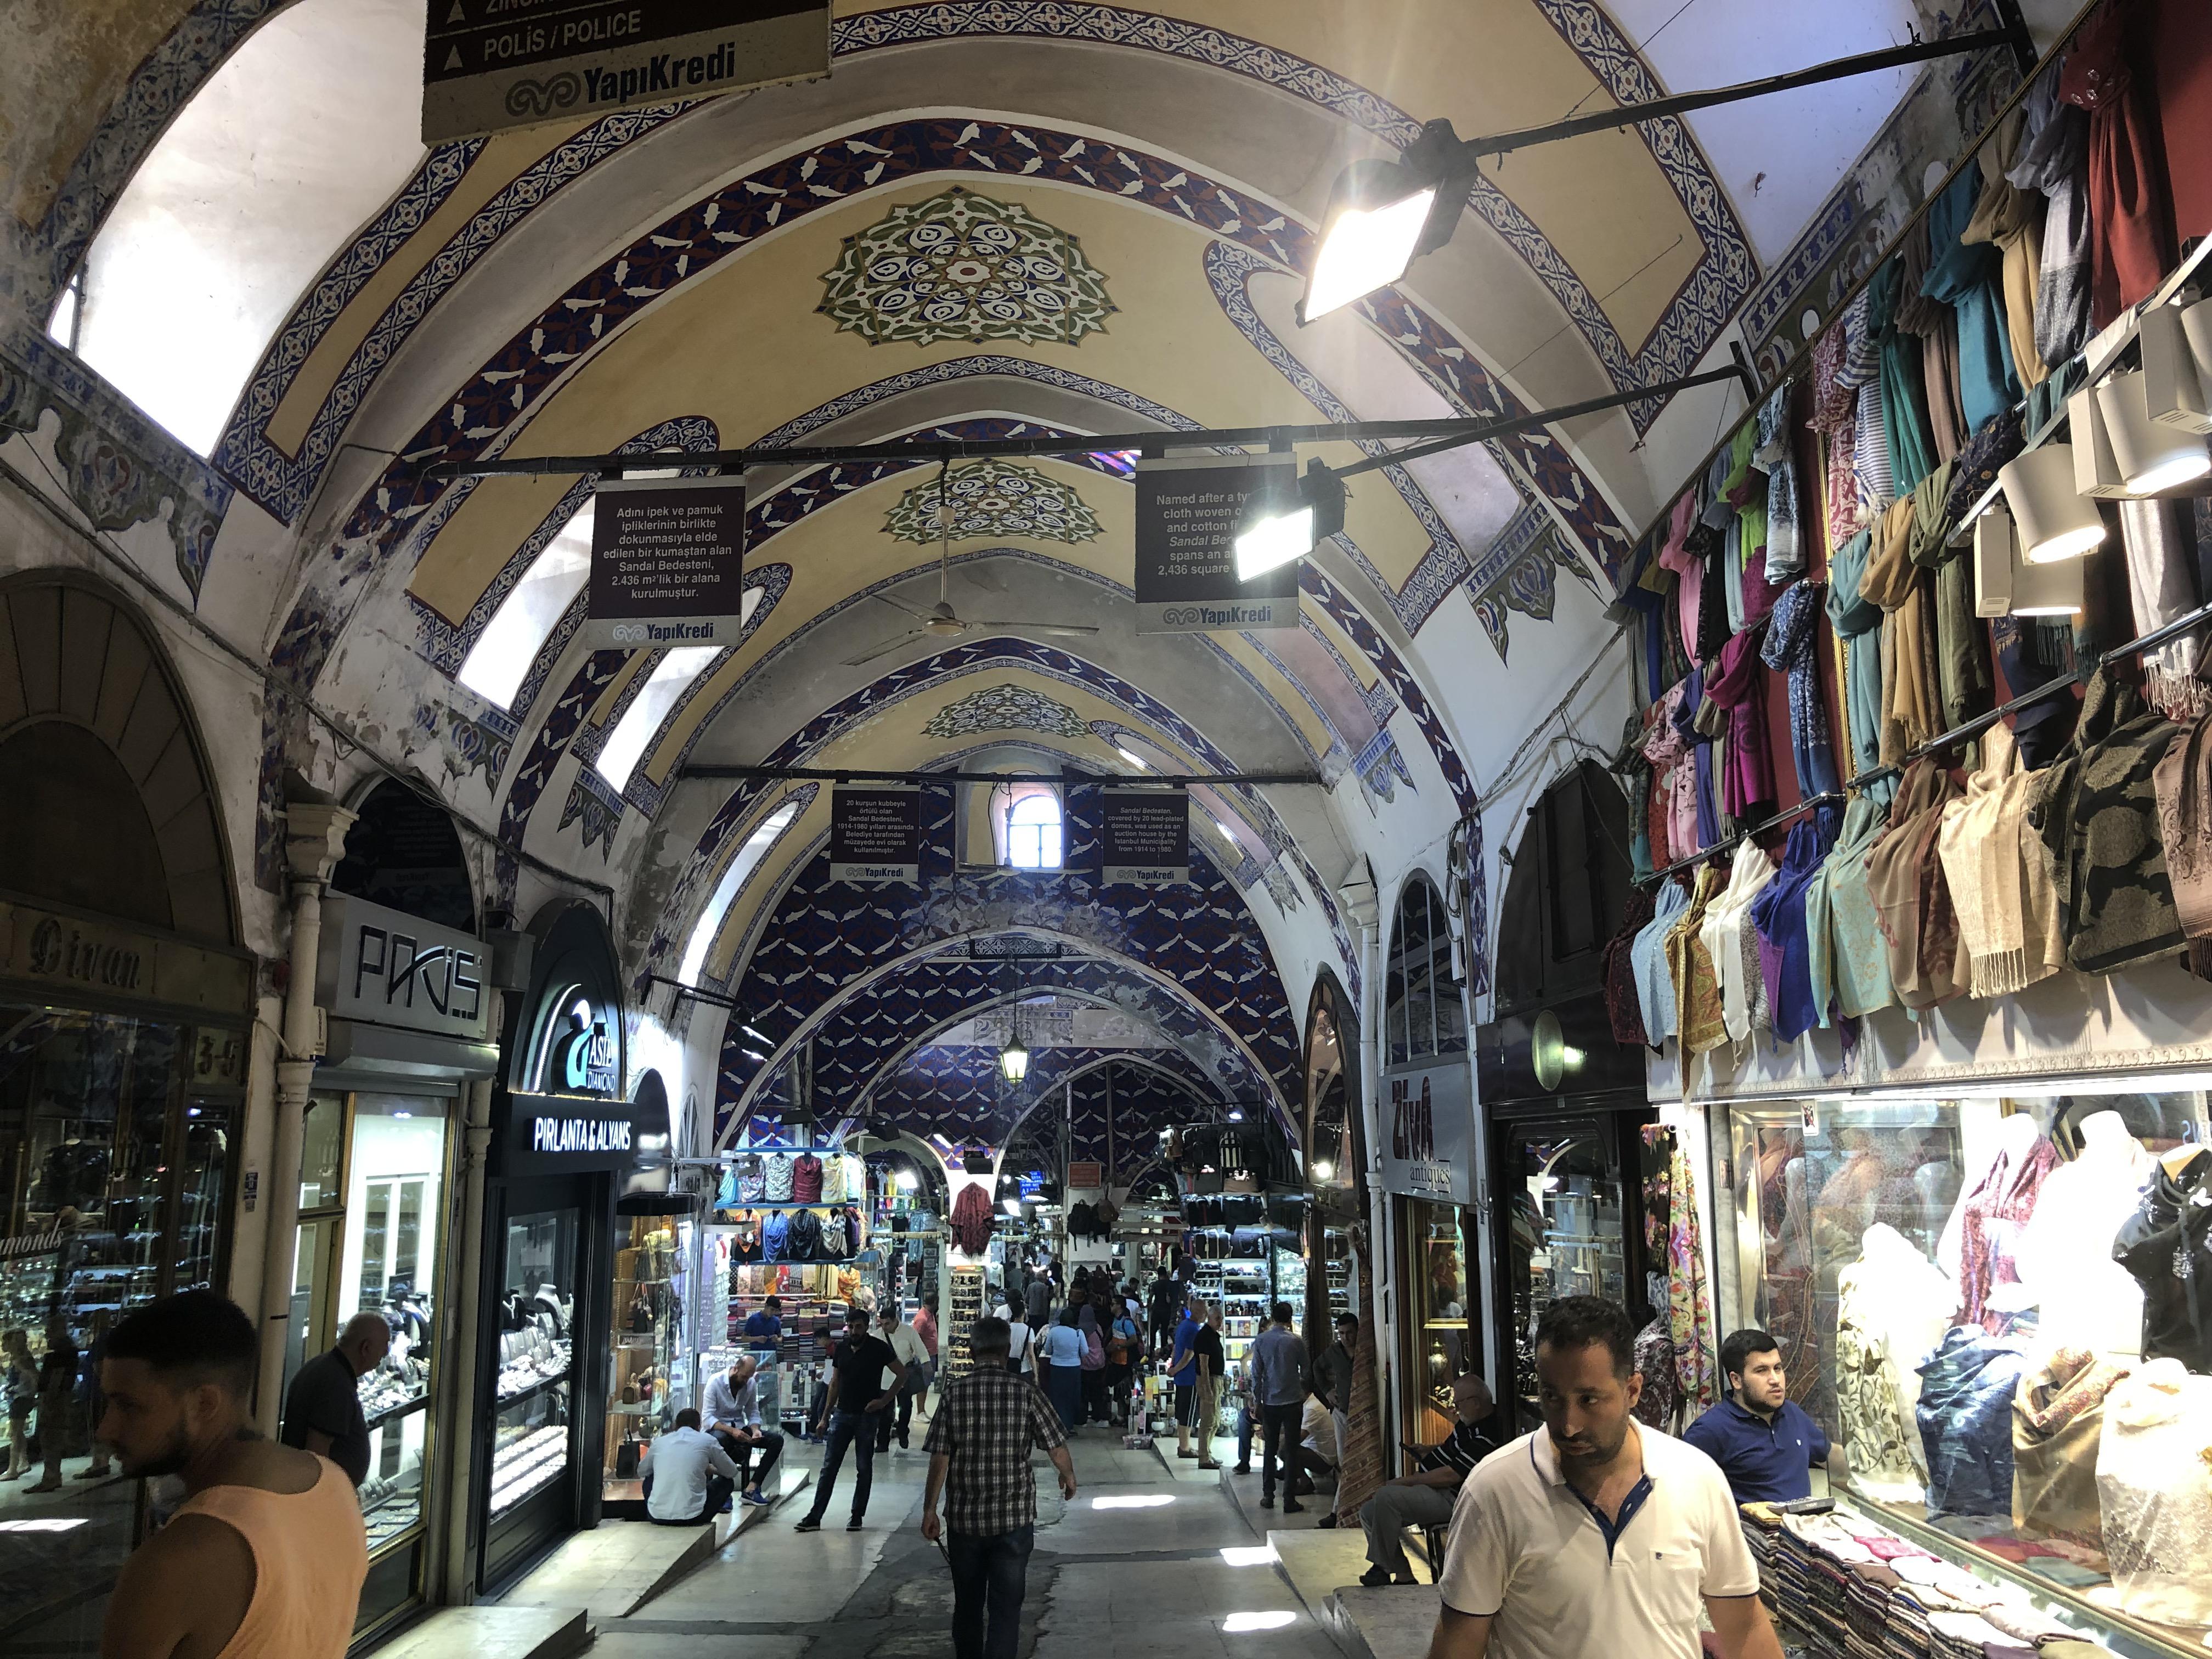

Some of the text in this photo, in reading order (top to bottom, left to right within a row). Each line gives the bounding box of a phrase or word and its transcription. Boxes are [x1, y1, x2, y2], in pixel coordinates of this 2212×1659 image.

[484, 9, 641, 61] POLİS / POLICE
[1157, 494, 1195, 505] Named
[1199, 493, 1224, 503] after
[617, 505, 723, 517] Adını ipek ve pamuk
[1164, 508, 1192, 518] cloth
[1195, 507, 1231, 517] woven
[622, 518, 716, 533] ipliklerinin birlikte
[1167, 522, 1187, 532] and
[1191, 521, 1226, 531] cotton
[619, 532, 717, 545] dokunmasıyla elde
[1170, 535, 1208, 546] Sandal
[603, 545, 731, 558] edilen bir kumaştan alan
[1170, 551, 1204, 562] spans
[1207, 550, 1220, 559] an
[619, 559, 714, 572] Sandal Bedesteni,
[1158, 564, 1229, 577] 2,436 square
[612, 575, 639, 585] 2.436
[675, 574, 689, 583] bir
[692, 573, 720, 583] alana
[631, 588, 698, 600] kurulmuştur.
[587, 1071, 615, 1092] DIAMOND
[1410, 1162, 1451, 1188] antiques
[0, 1218, 64, 1255] monds
